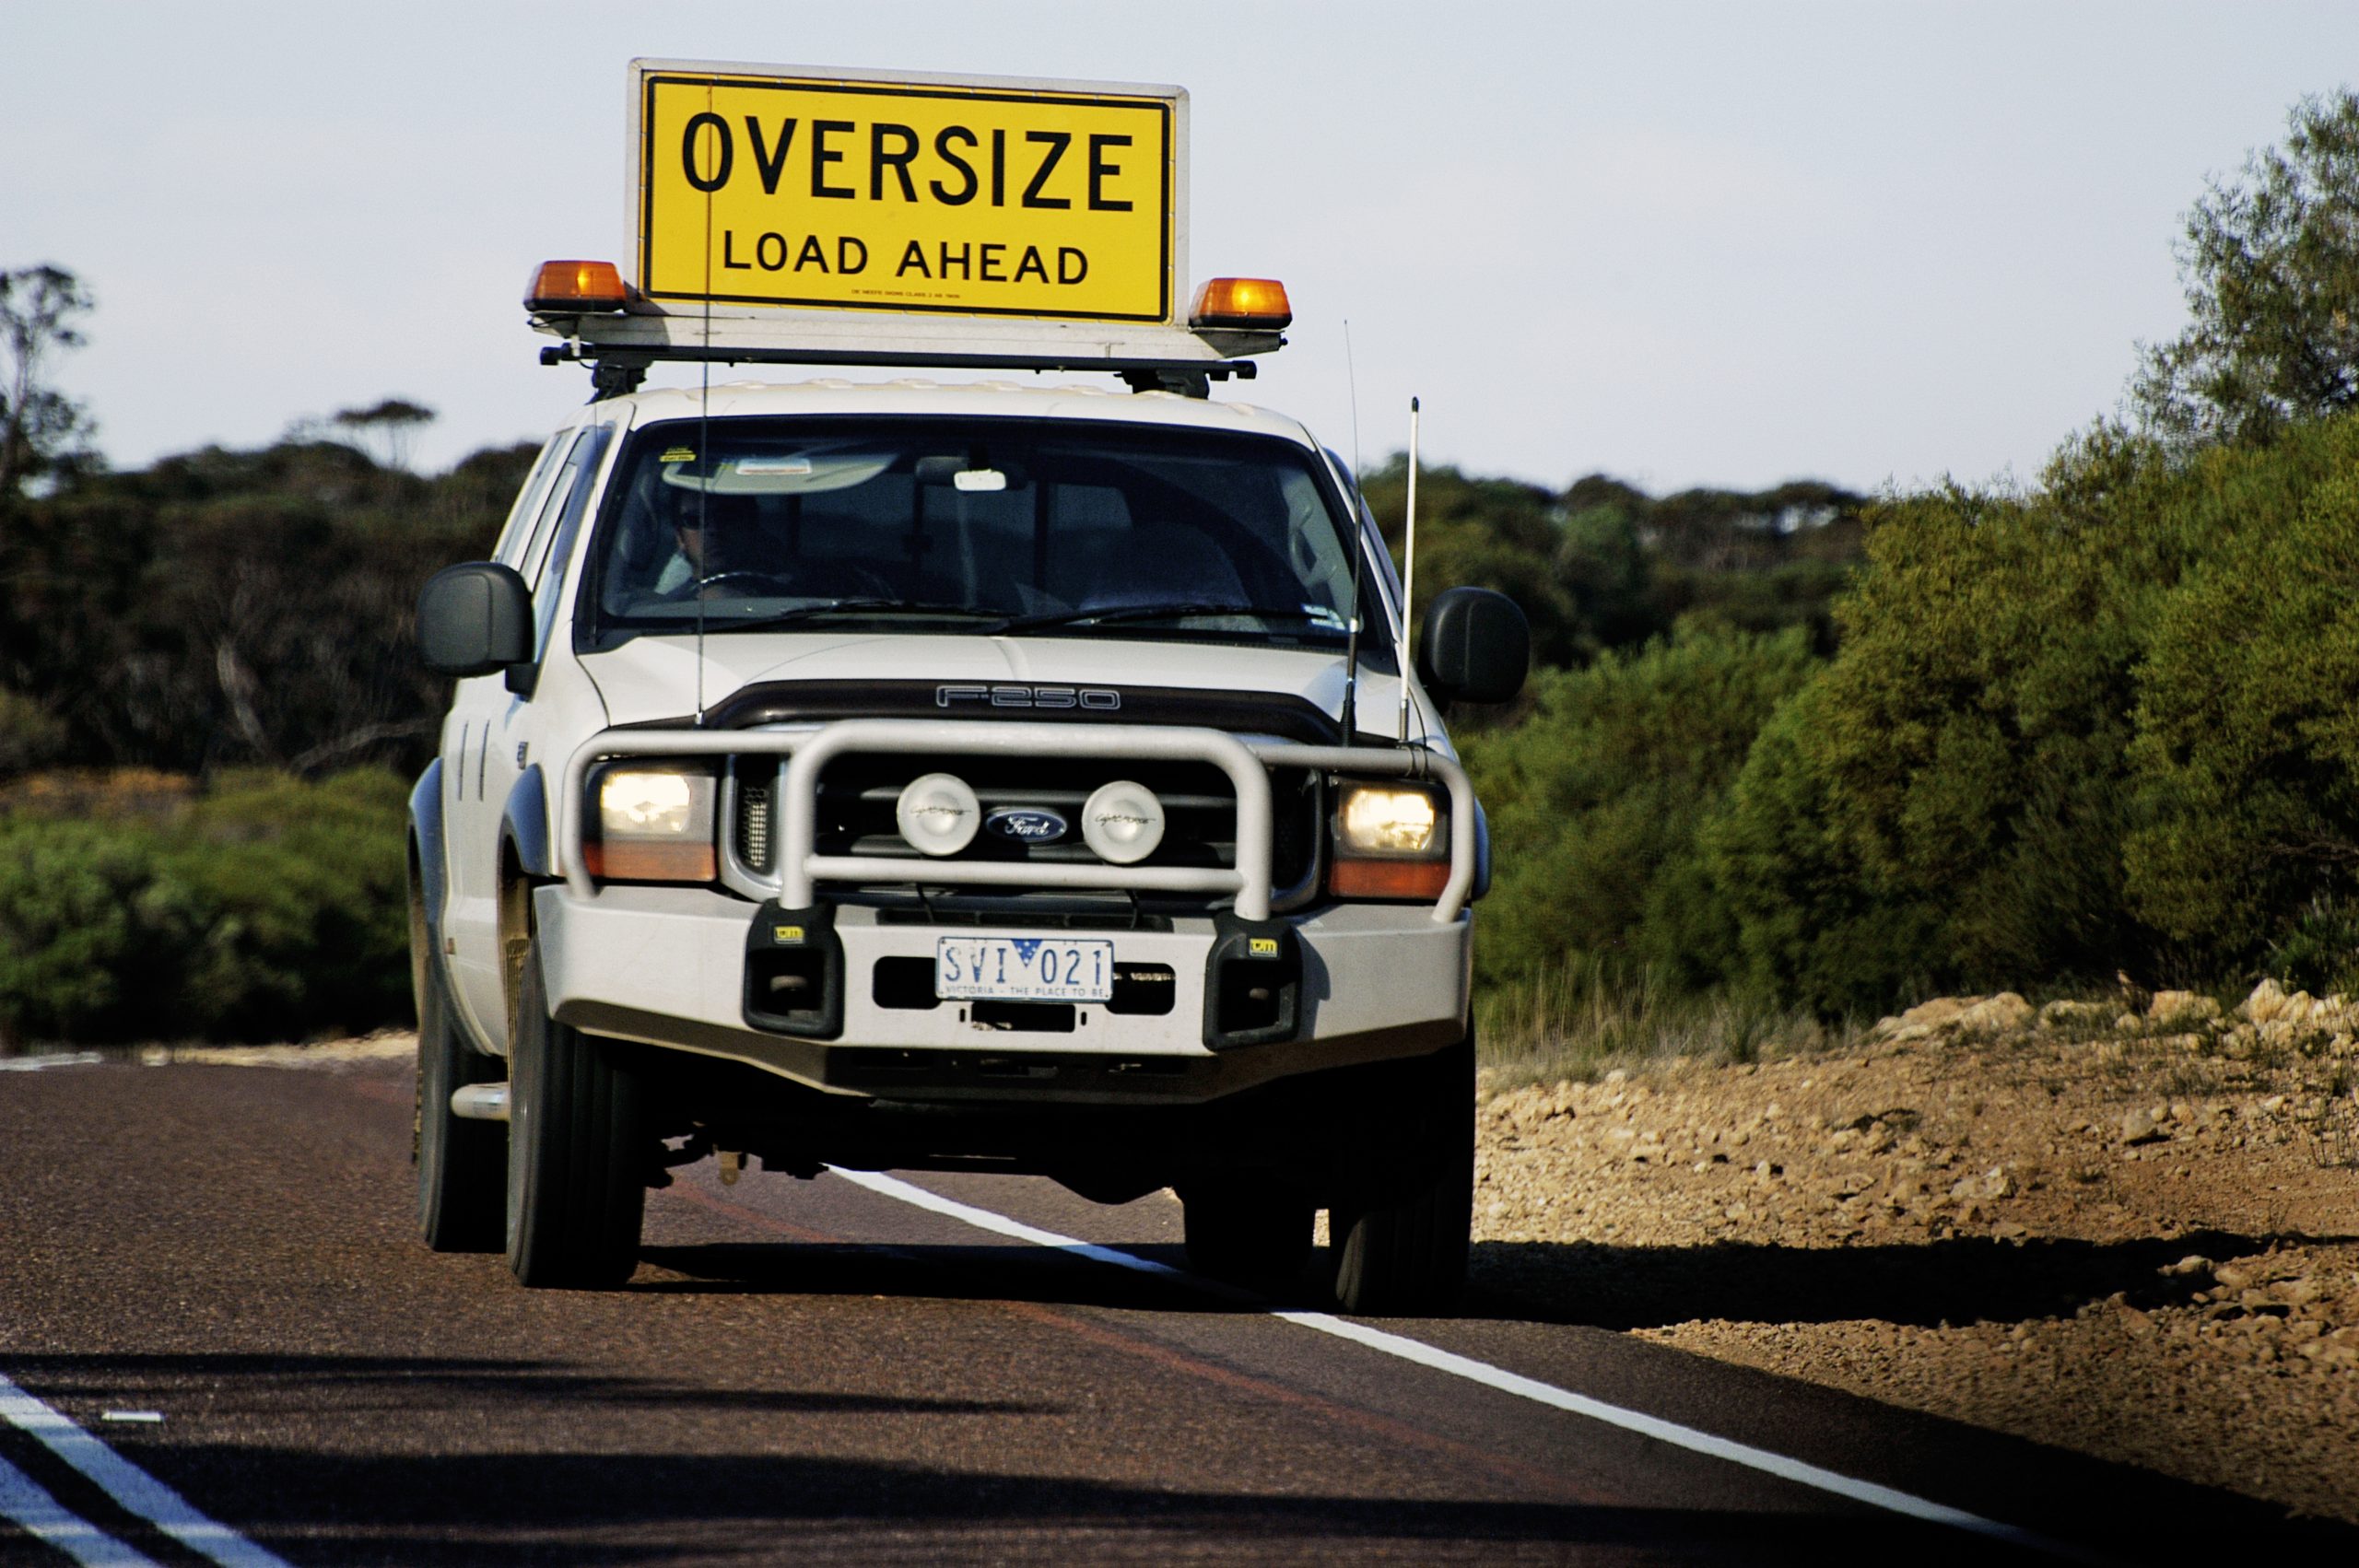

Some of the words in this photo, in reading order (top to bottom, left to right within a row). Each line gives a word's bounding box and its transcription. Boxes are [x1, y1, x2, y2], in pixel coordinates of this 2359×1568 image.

[681, 111, 1134, 213] OVERSIZE
[723, 229, 869, 276] LOAD
[896, 240, 1089, 286] AHEAD
[1004, 816, 1050, 836] Ford
[945, 946, 1006, 984] SVI
[1040, 948, 1102, 986] 021
[945, 986, 994, 995] VICTORIA
[1010, 987, 1029, 996] THE
[1035, 988, 1066, 997] PLACE
[1073, 988, 1086, 998] TO
[1092, 989, 1104, 998] BE
